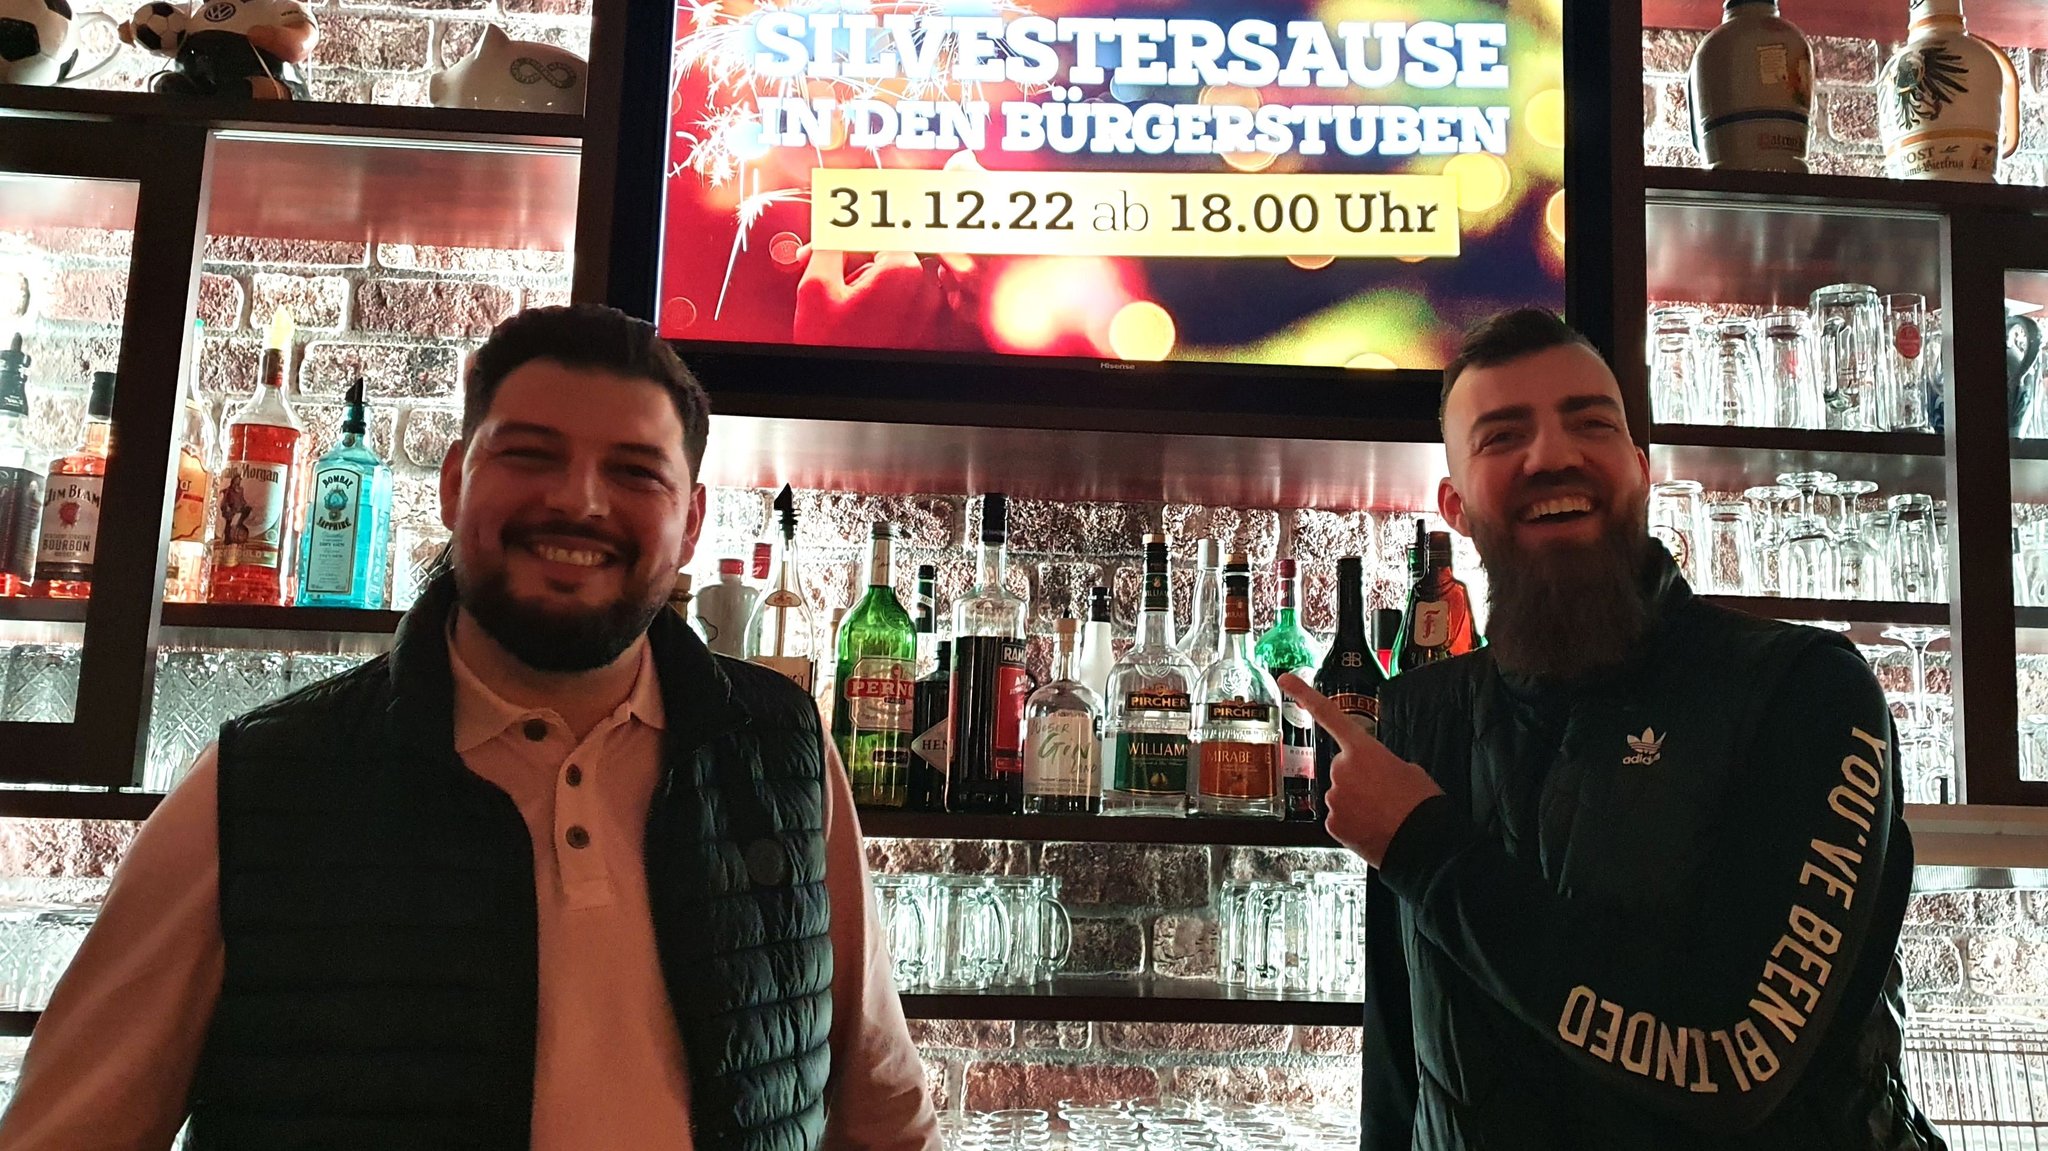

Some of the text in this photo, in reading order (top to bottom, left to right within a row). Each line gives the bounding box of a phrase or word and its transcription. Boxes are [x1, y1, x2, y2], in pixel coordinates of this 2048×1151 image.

[755, 12, 1510, 88] SILVESTERSAUSE
[758, 86, 1511, 156] IN DEN BÜRGERSTUBEN
[829, 187, 1438, 233] 31.12.22 ab 18.00 Uhr
[1100, 362, 1136, 370] Hisense
[241, 463, 280, 484] Morgan
[322, 475, 354, 489] BOMBAY
[44, 488, 66, 507] JIM
[316, 516, 352, 531] SAPPHIRE
[42, 539, 91, 553] BOURBON
[851, 680, 914, 697] PERNO
[1131, 697, 1188, 707] PIRCHER
[1213, 708, 1266, 718] PIRCHER
[1557, 727, 1888, 1093] YOU'VE BEEN BLINDED
